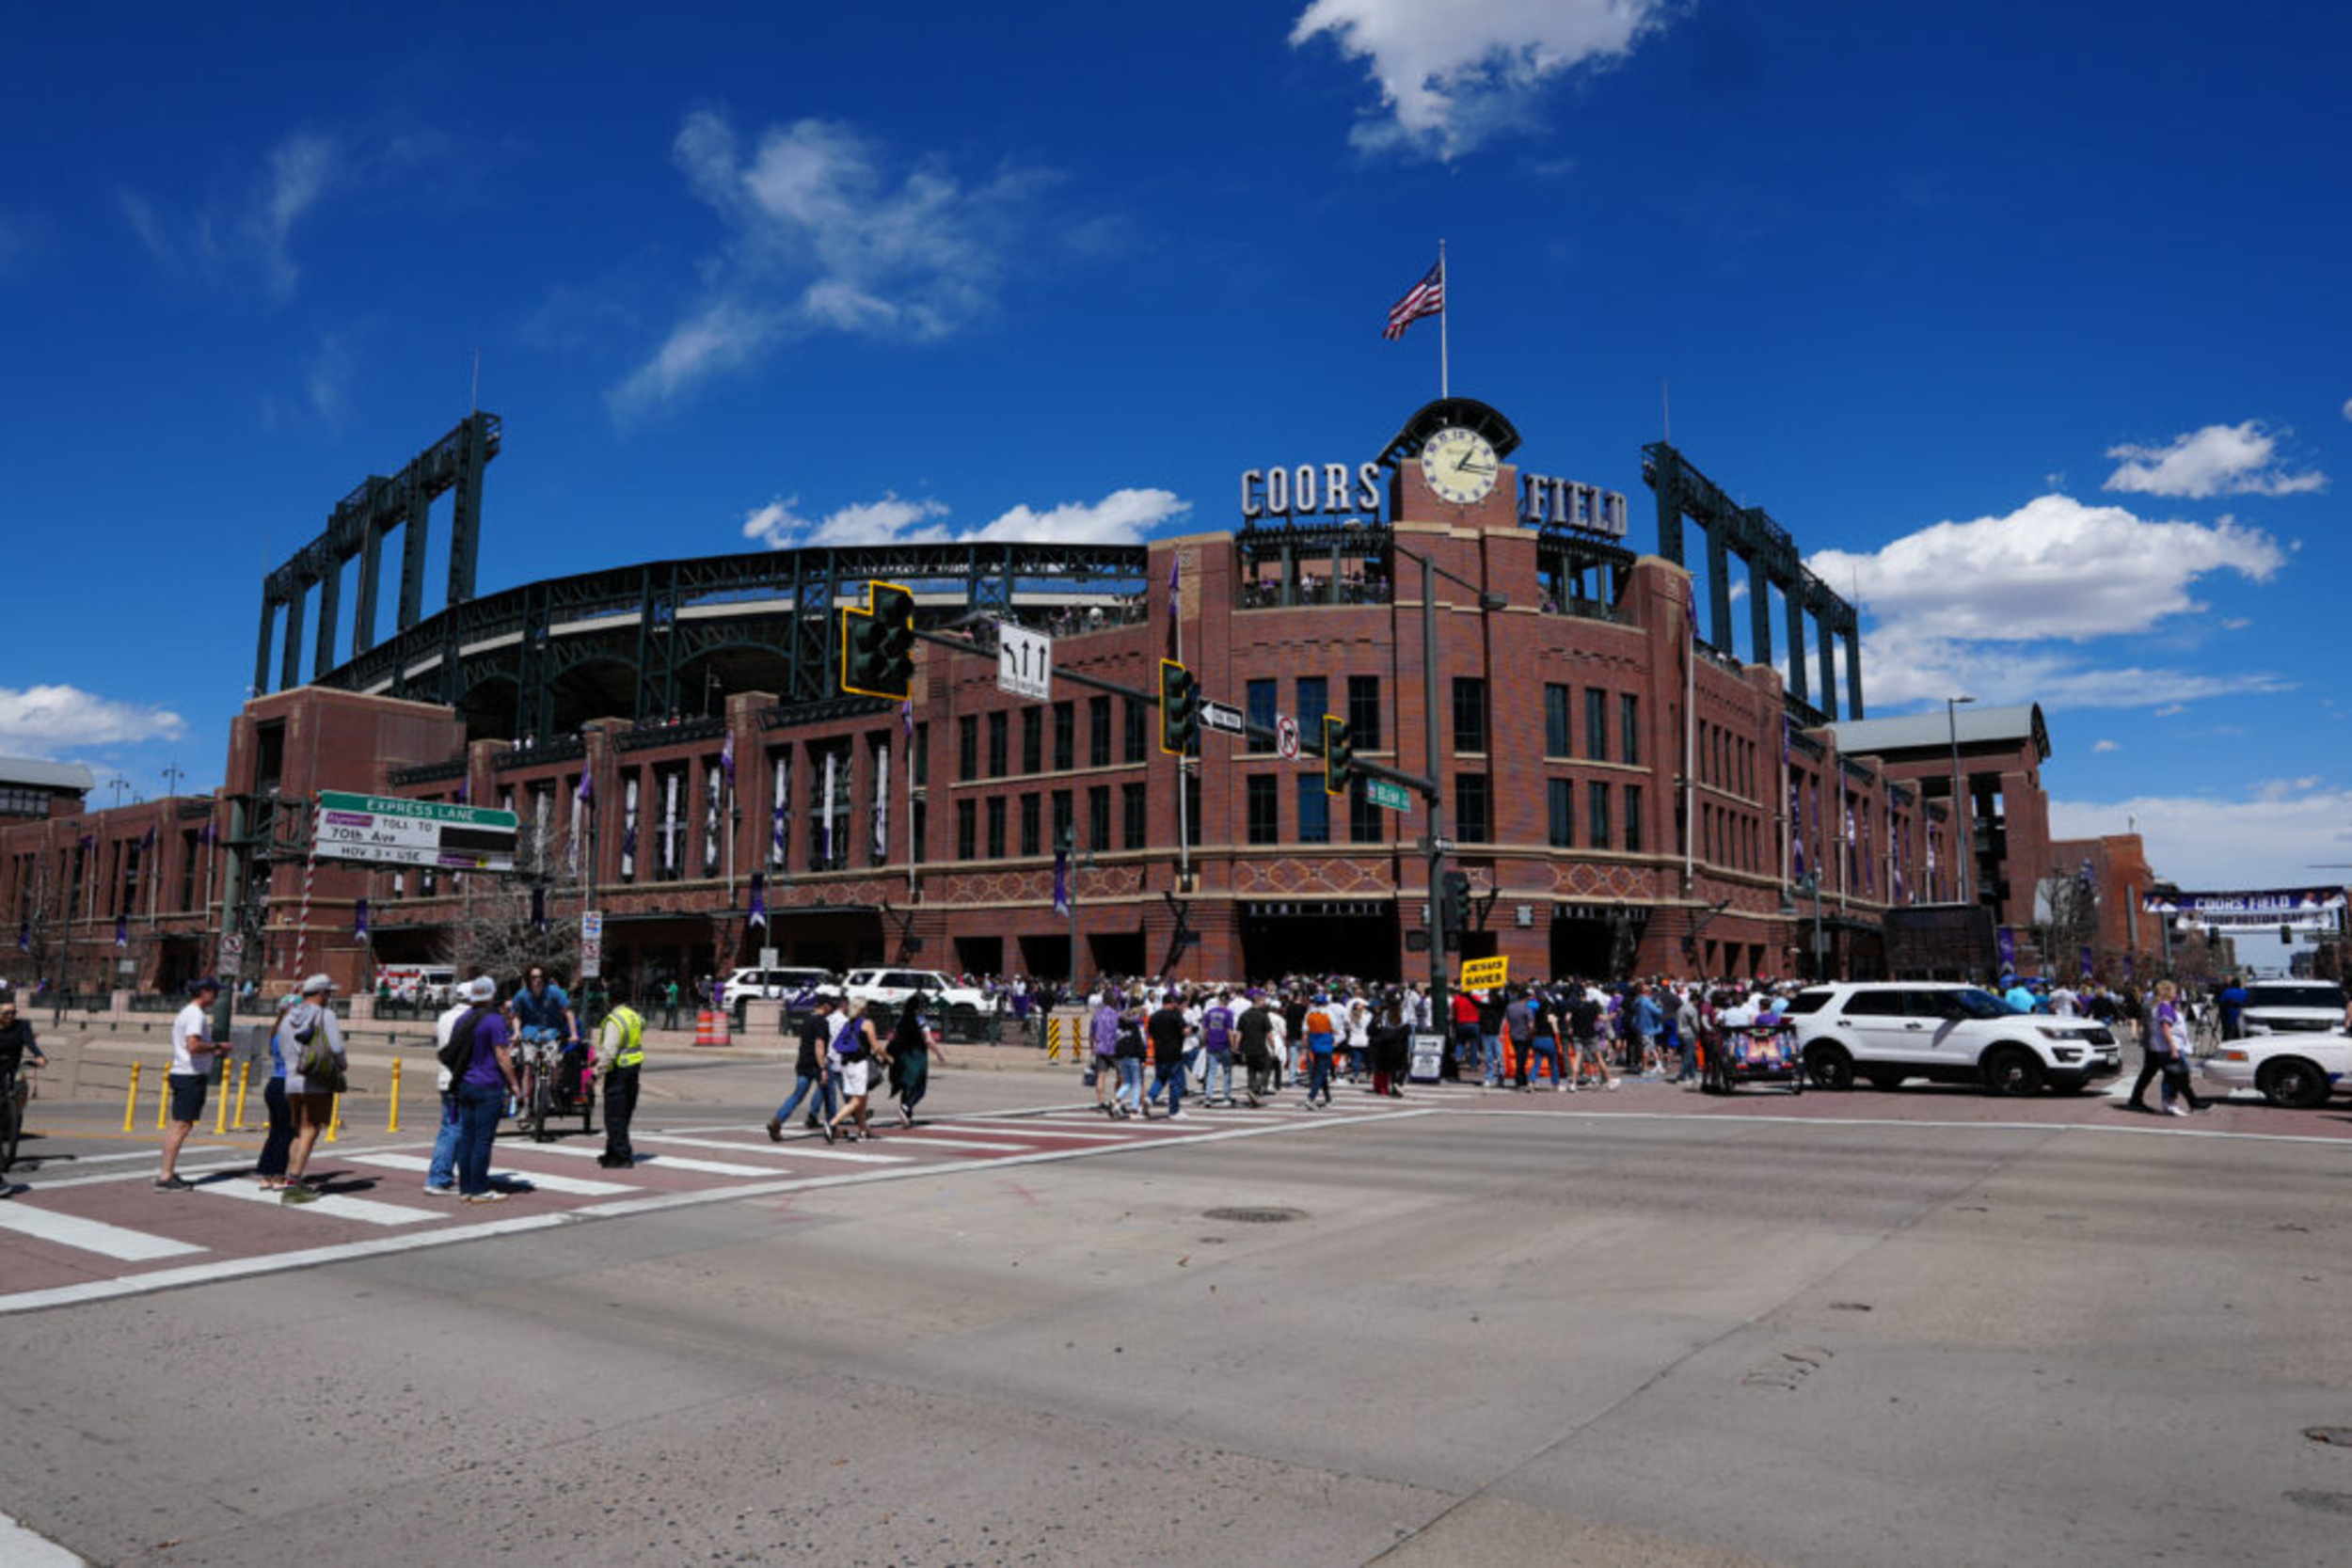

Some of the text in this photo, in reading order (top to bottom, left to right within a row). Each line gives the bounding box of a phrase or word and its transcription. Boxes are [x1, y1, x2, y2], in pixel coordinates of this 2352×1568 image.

[1242, 461, 1628, 536] COORS FIELD
[366, 799, 475, 822] EXPRESS LANE
[383, 817, 408, 830] TOLL
[419, 820, 433, 832] TO
[331, 828, 396, 843] 70th Ave
[342, 847, 367, 857] HOV
[396, 850, 421, 862] USE
[2195, 895, 2291, 911] COORS FIELD
[1465, 960, 1502, 974] JESUS
